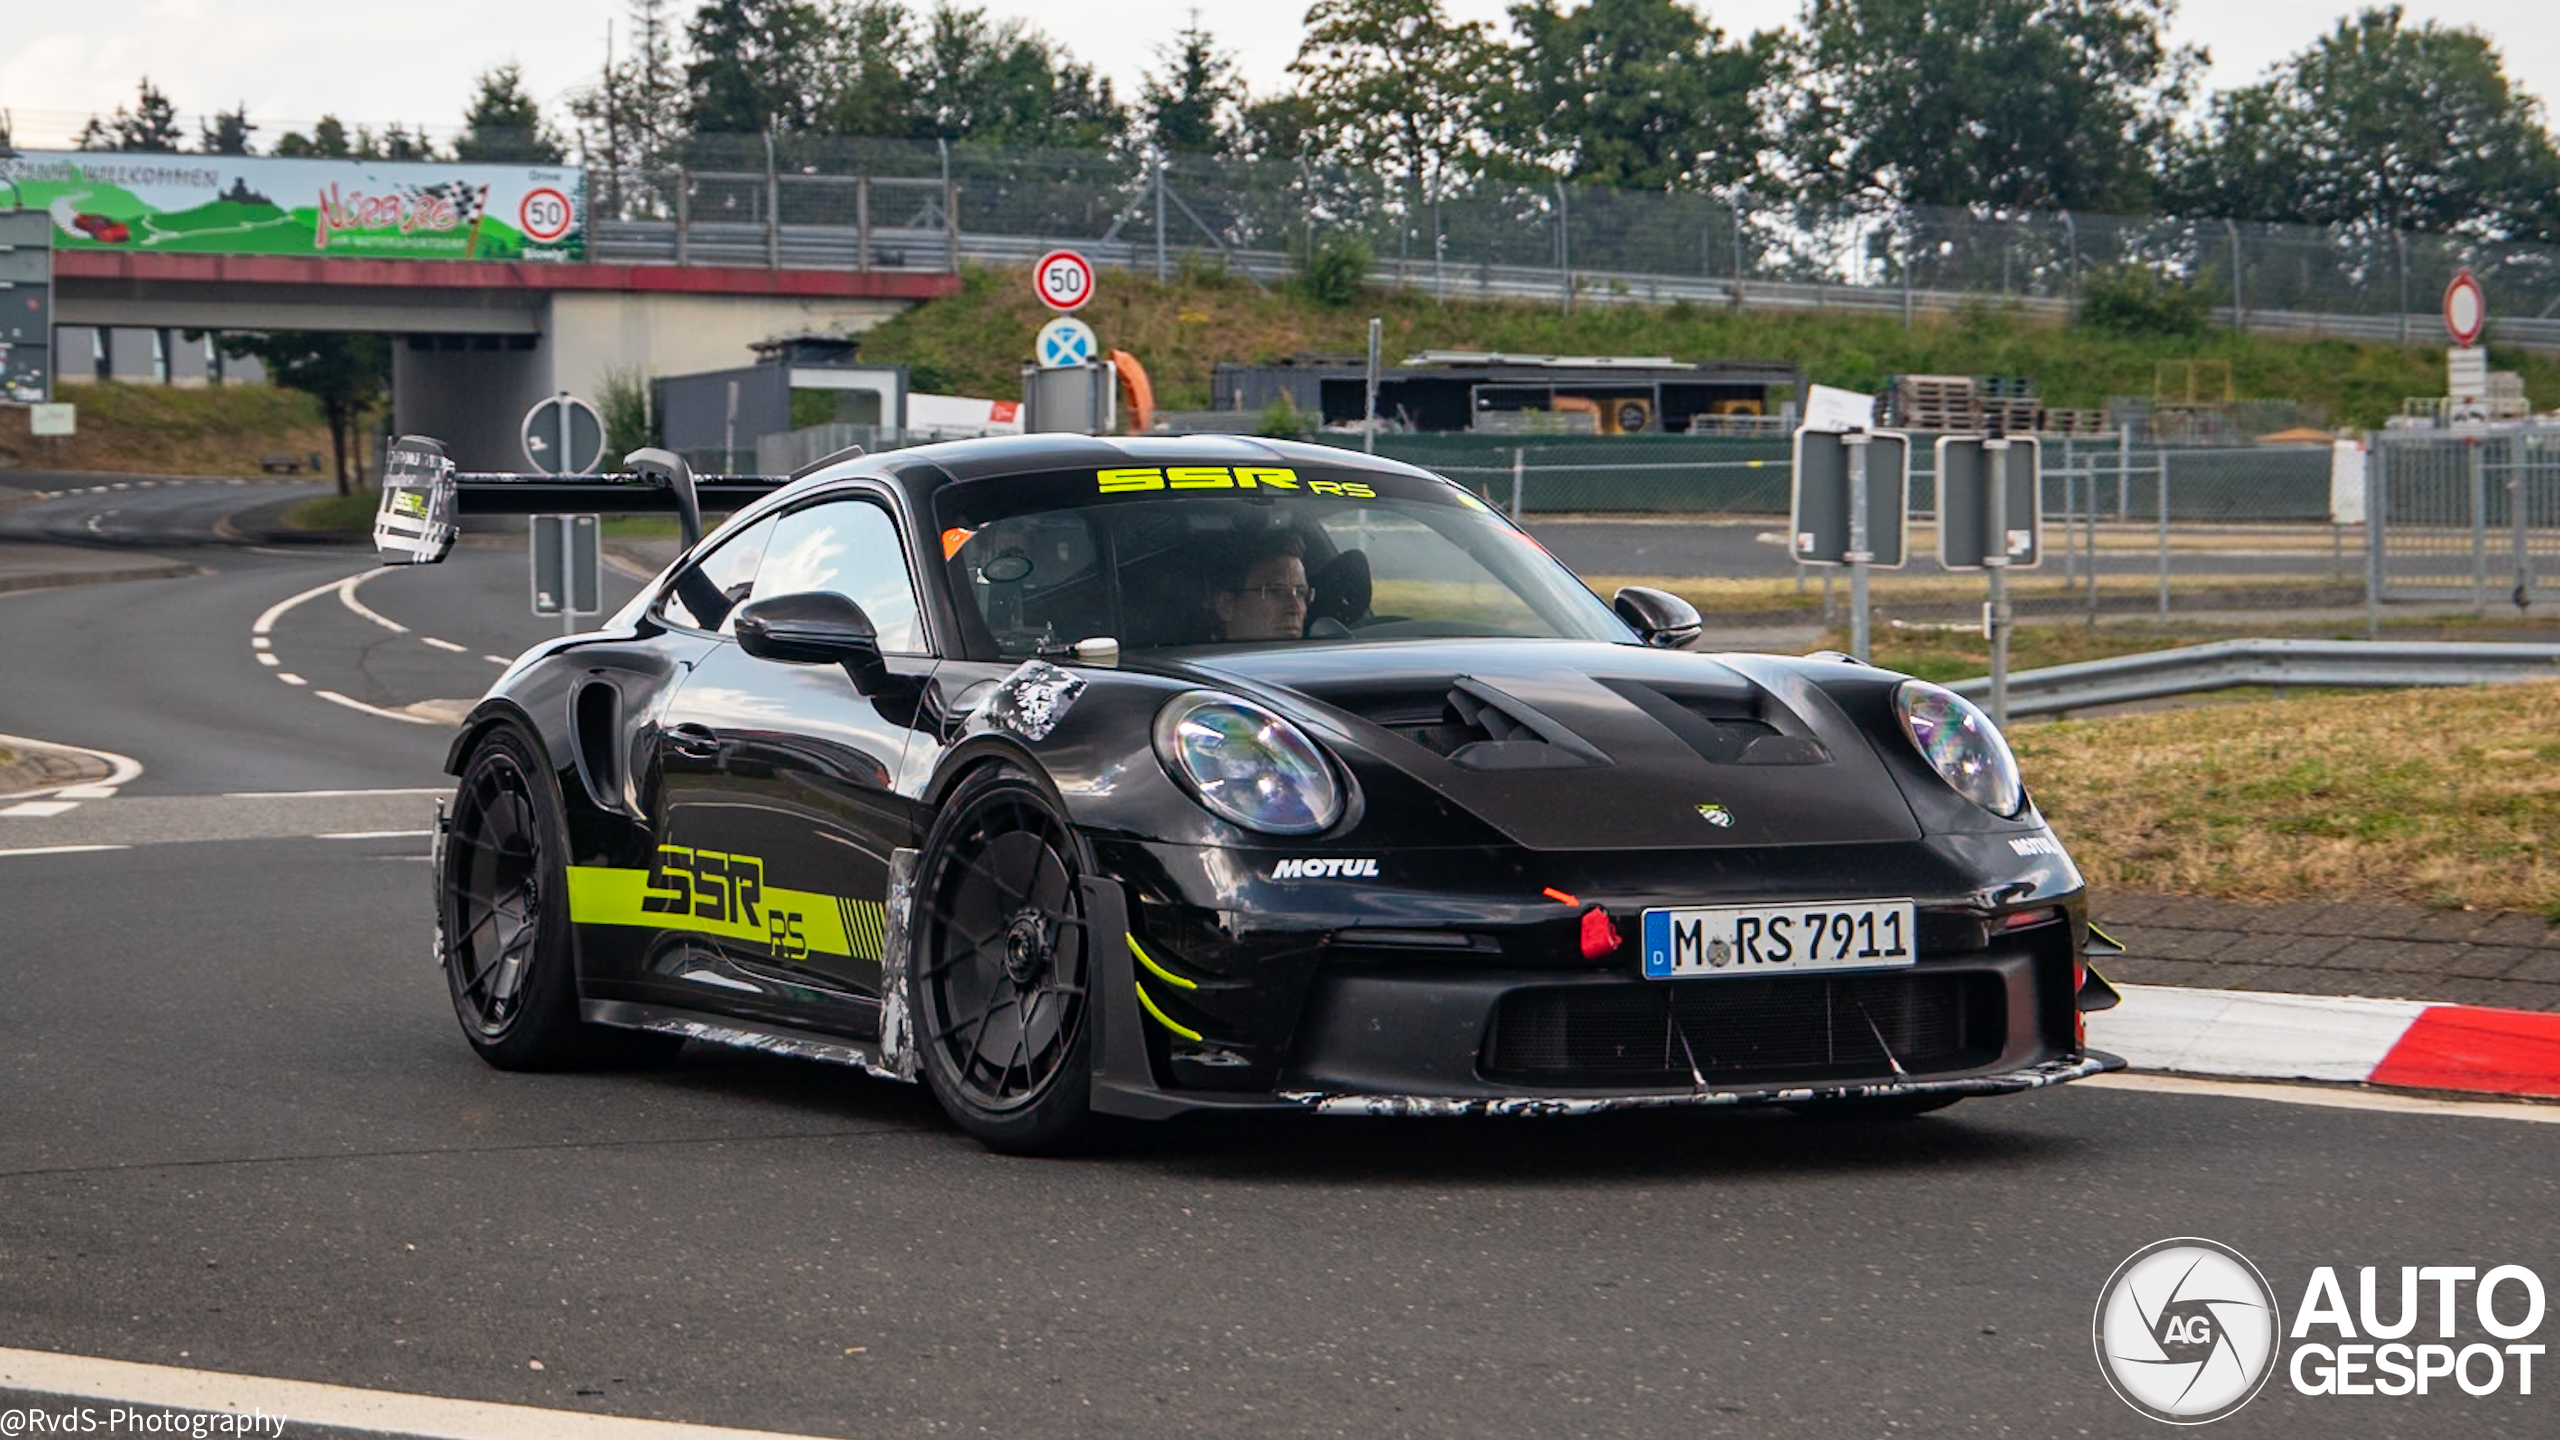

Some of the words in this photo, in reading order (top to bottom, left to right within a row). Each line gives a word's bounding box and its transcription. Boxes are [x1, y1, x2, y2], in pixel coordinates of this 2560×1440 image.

[83, 164, 219, 187] WILLKOMMEN
[531, 201, 561, 226] 50
[1049, 268, 1081, 292] 50
[1096, 466, 1300, 494] SSR
[1308, 479, 1377, 499] RS
[1272, 858, 1379, 879] MOTUL
[641, 844, 763, 927] SSR
[768, 909, 809, 959] RS
[1674, 919, 1702, 966] M
[1736, 916, 1793, 965] RS
[1805, 911, 1907, 960] 7911
[1652, 951, 1664, 966] D
